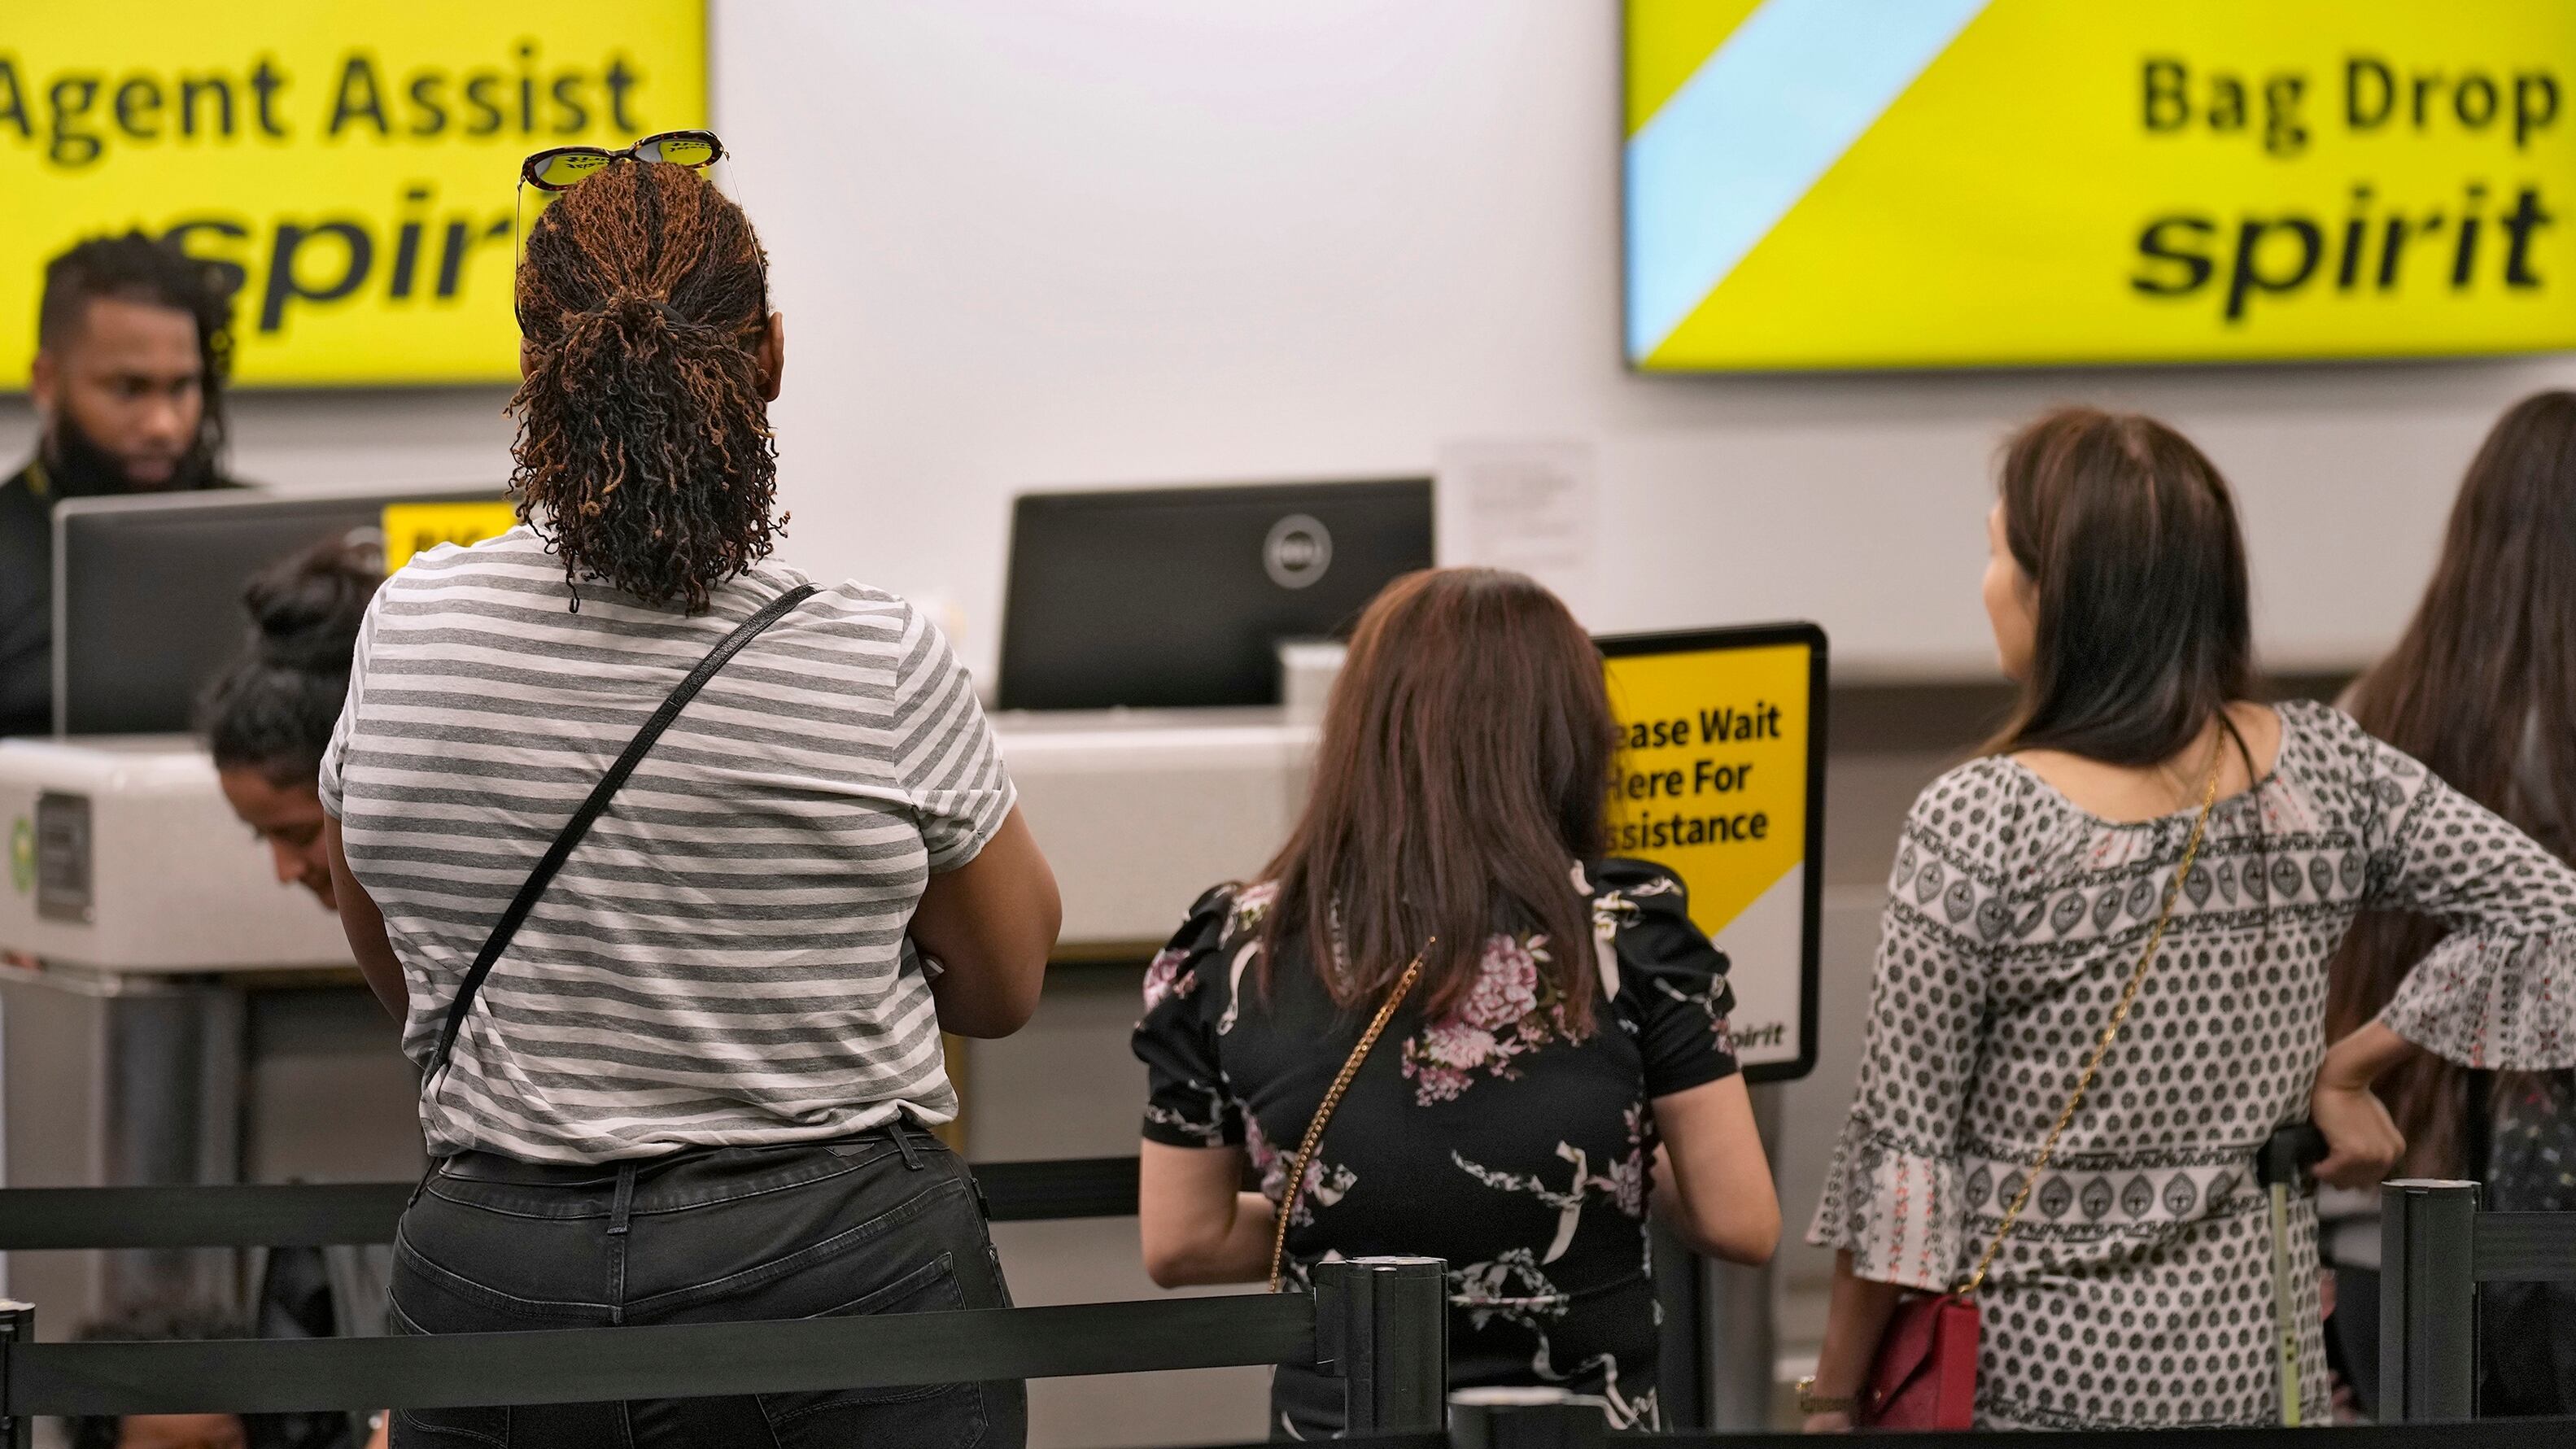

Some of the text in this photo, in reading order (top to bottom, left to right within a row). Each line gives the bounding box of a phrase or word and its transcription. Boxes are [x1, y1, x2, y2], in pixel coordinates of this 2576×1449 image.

[329, 43, 644, 137] Assist
[2141, 57, 2562, 156] Bag Drop
[165, 189, 513, 332] spir
[2130, 183, 2552, 322] spirit
[1612, 700, 1781, 749] ease Wait
[1695, 760, 1753, 794] For
[1604, 810, 1768, 851] ssistance
[1730, 1022, 1785, 1048] pirit
